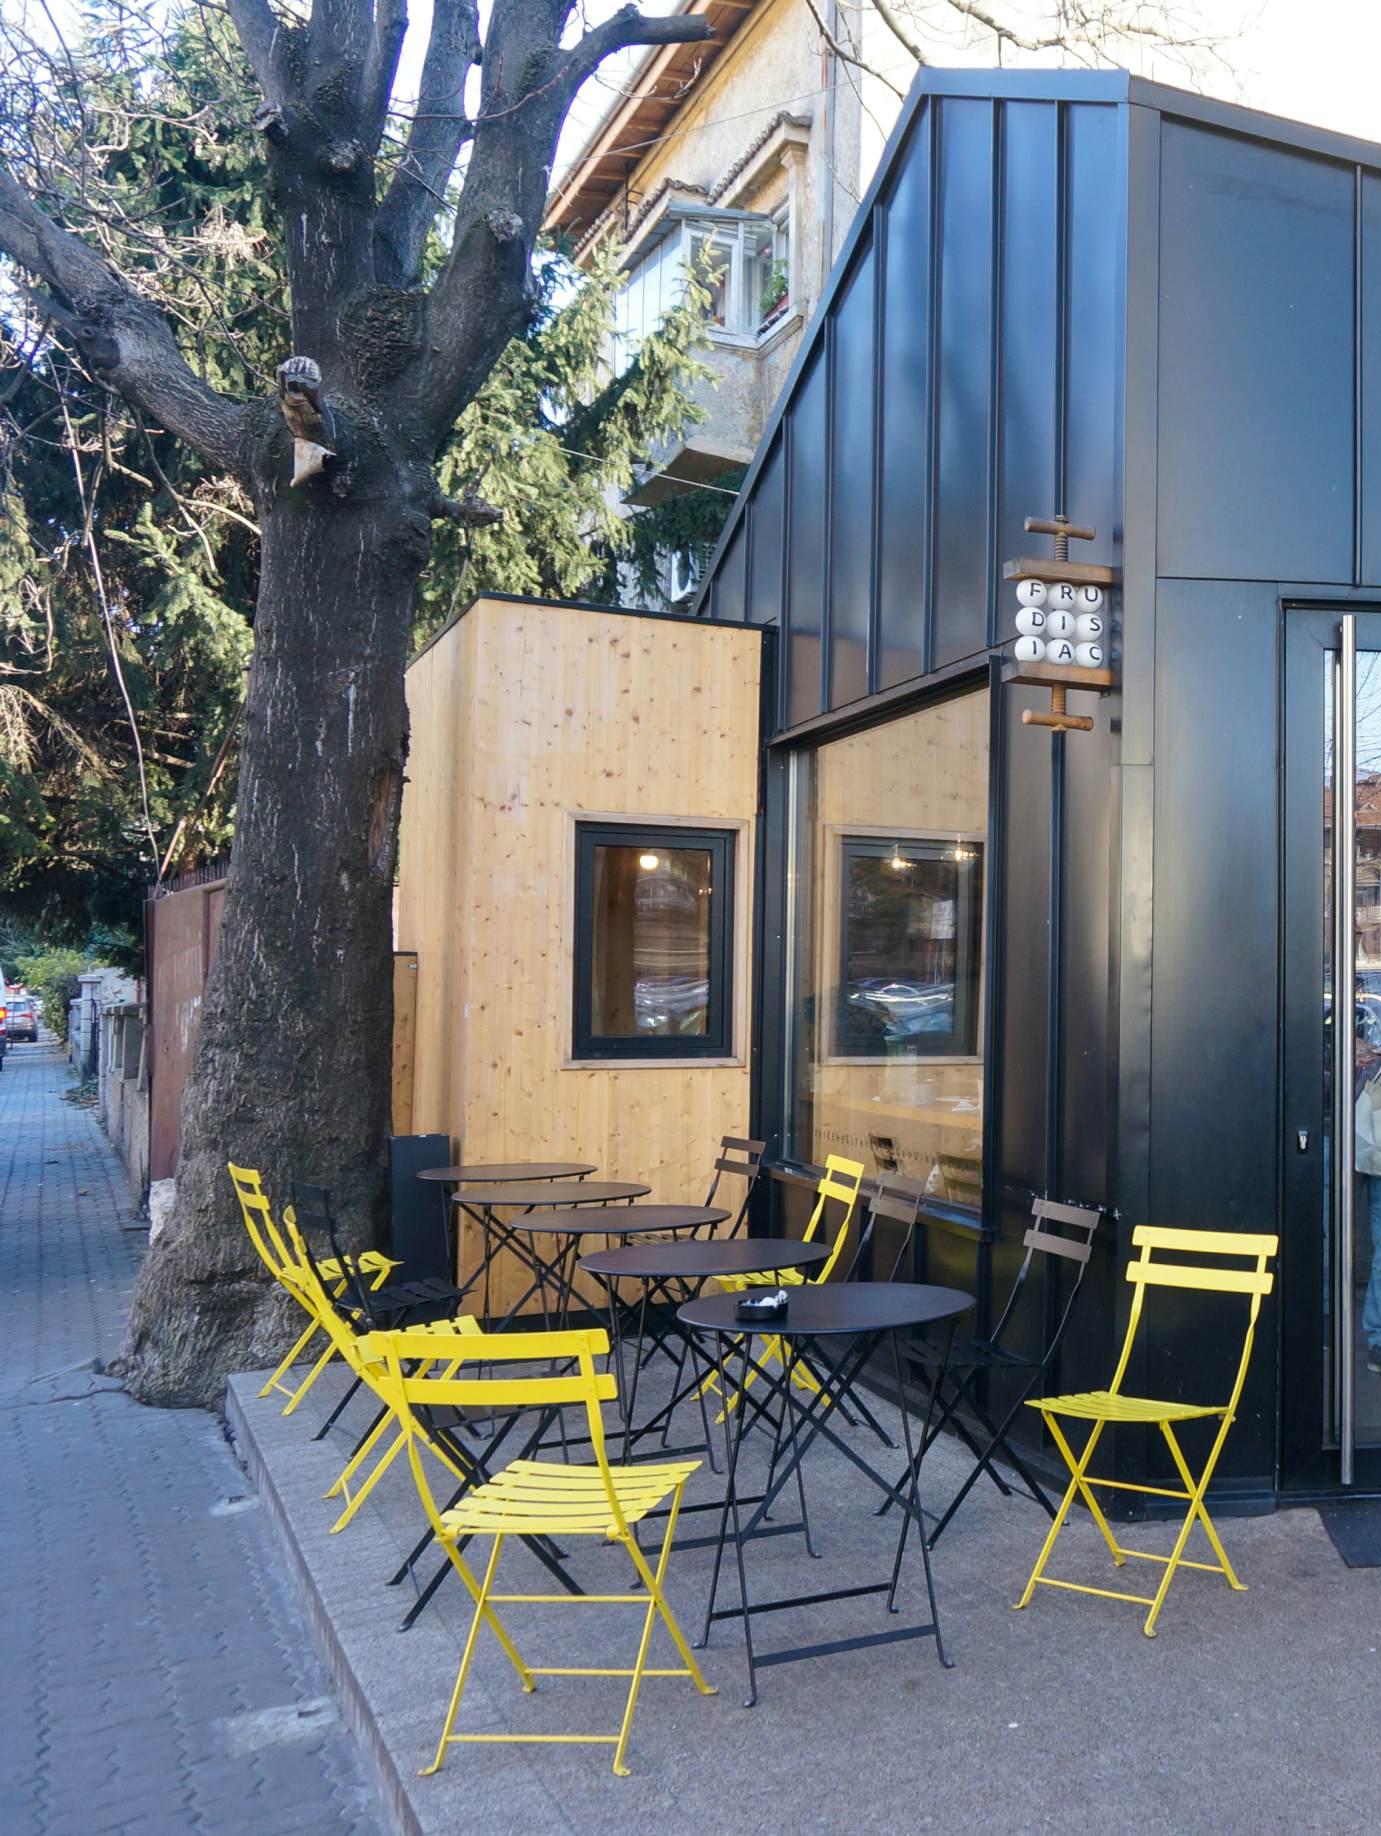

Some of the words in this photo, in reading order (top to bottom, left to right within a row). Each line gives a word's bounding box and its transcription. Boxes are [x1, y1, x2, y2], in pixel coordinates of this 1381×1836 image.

[1029, 582, 1099, 602] FRU
[1031, 611, 1101, 632] DIS
[1032, 640, 1101, 660] IAC
